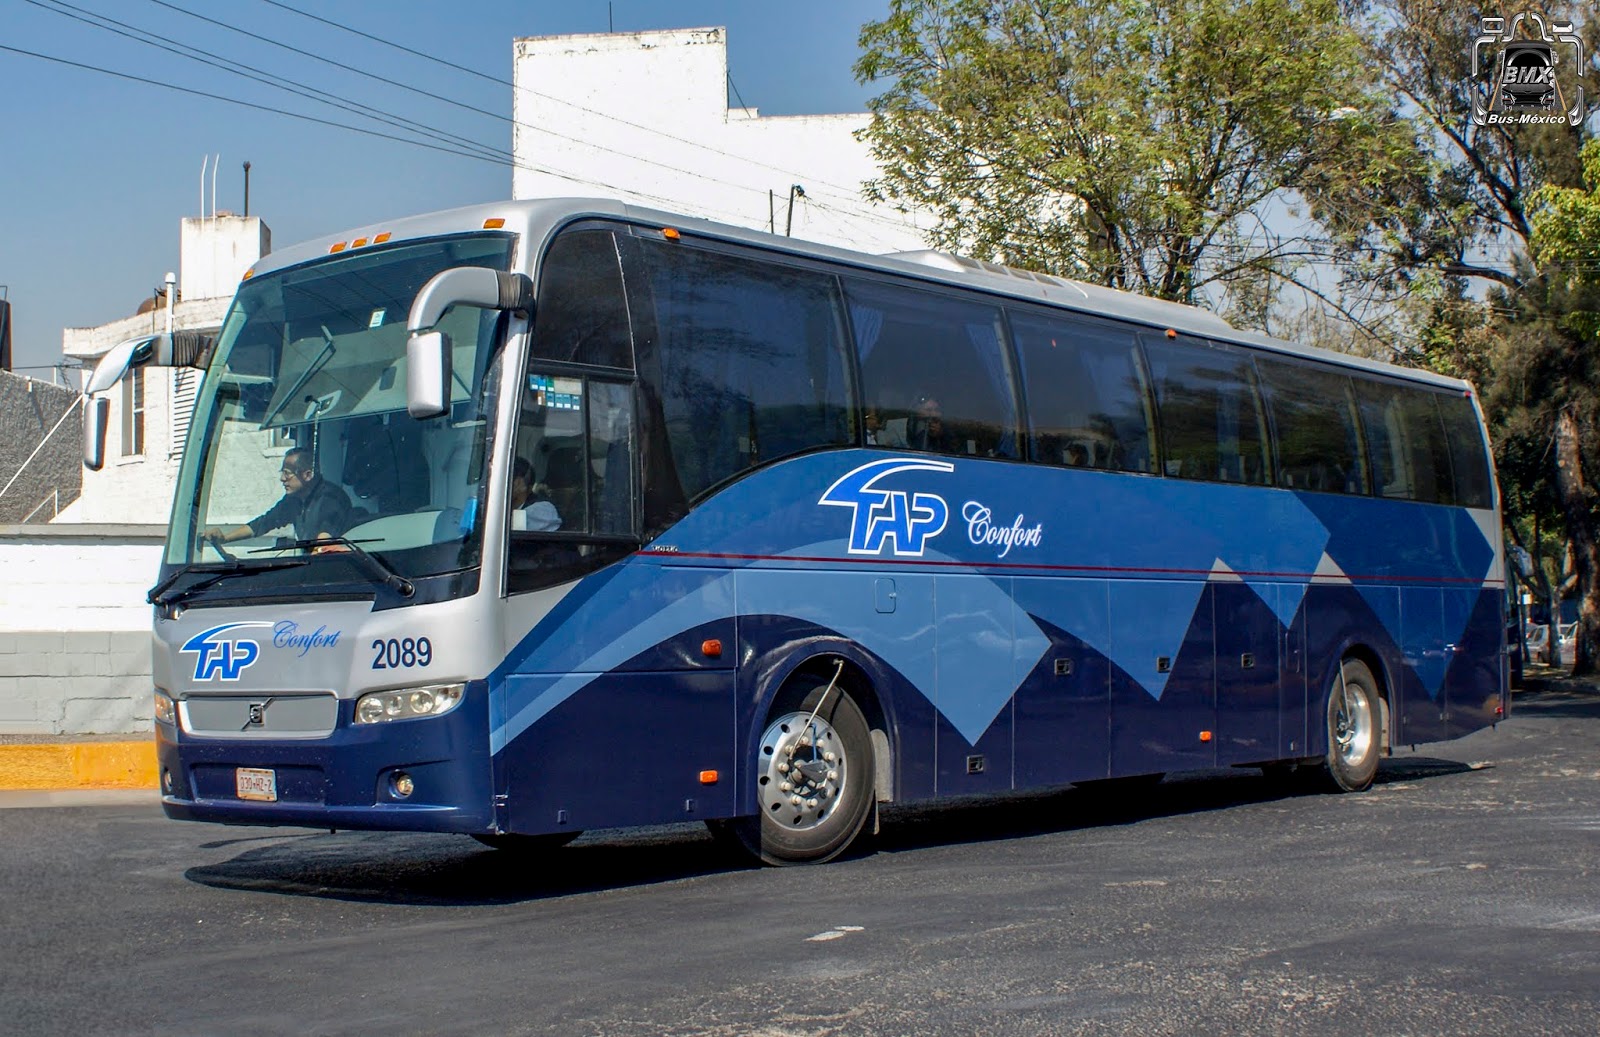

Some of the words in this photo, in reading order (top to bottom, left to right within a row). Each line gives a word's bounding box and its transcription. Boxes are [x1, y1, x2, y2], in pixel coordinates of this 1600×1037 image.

[818, 458, 954, 556] TAP
[962, 501, 1041, 558] Confort
[179, 621, 274, 681] TAP
[273, 620, 341, 657] Confort
[372, 637, 432, 669] 2089
